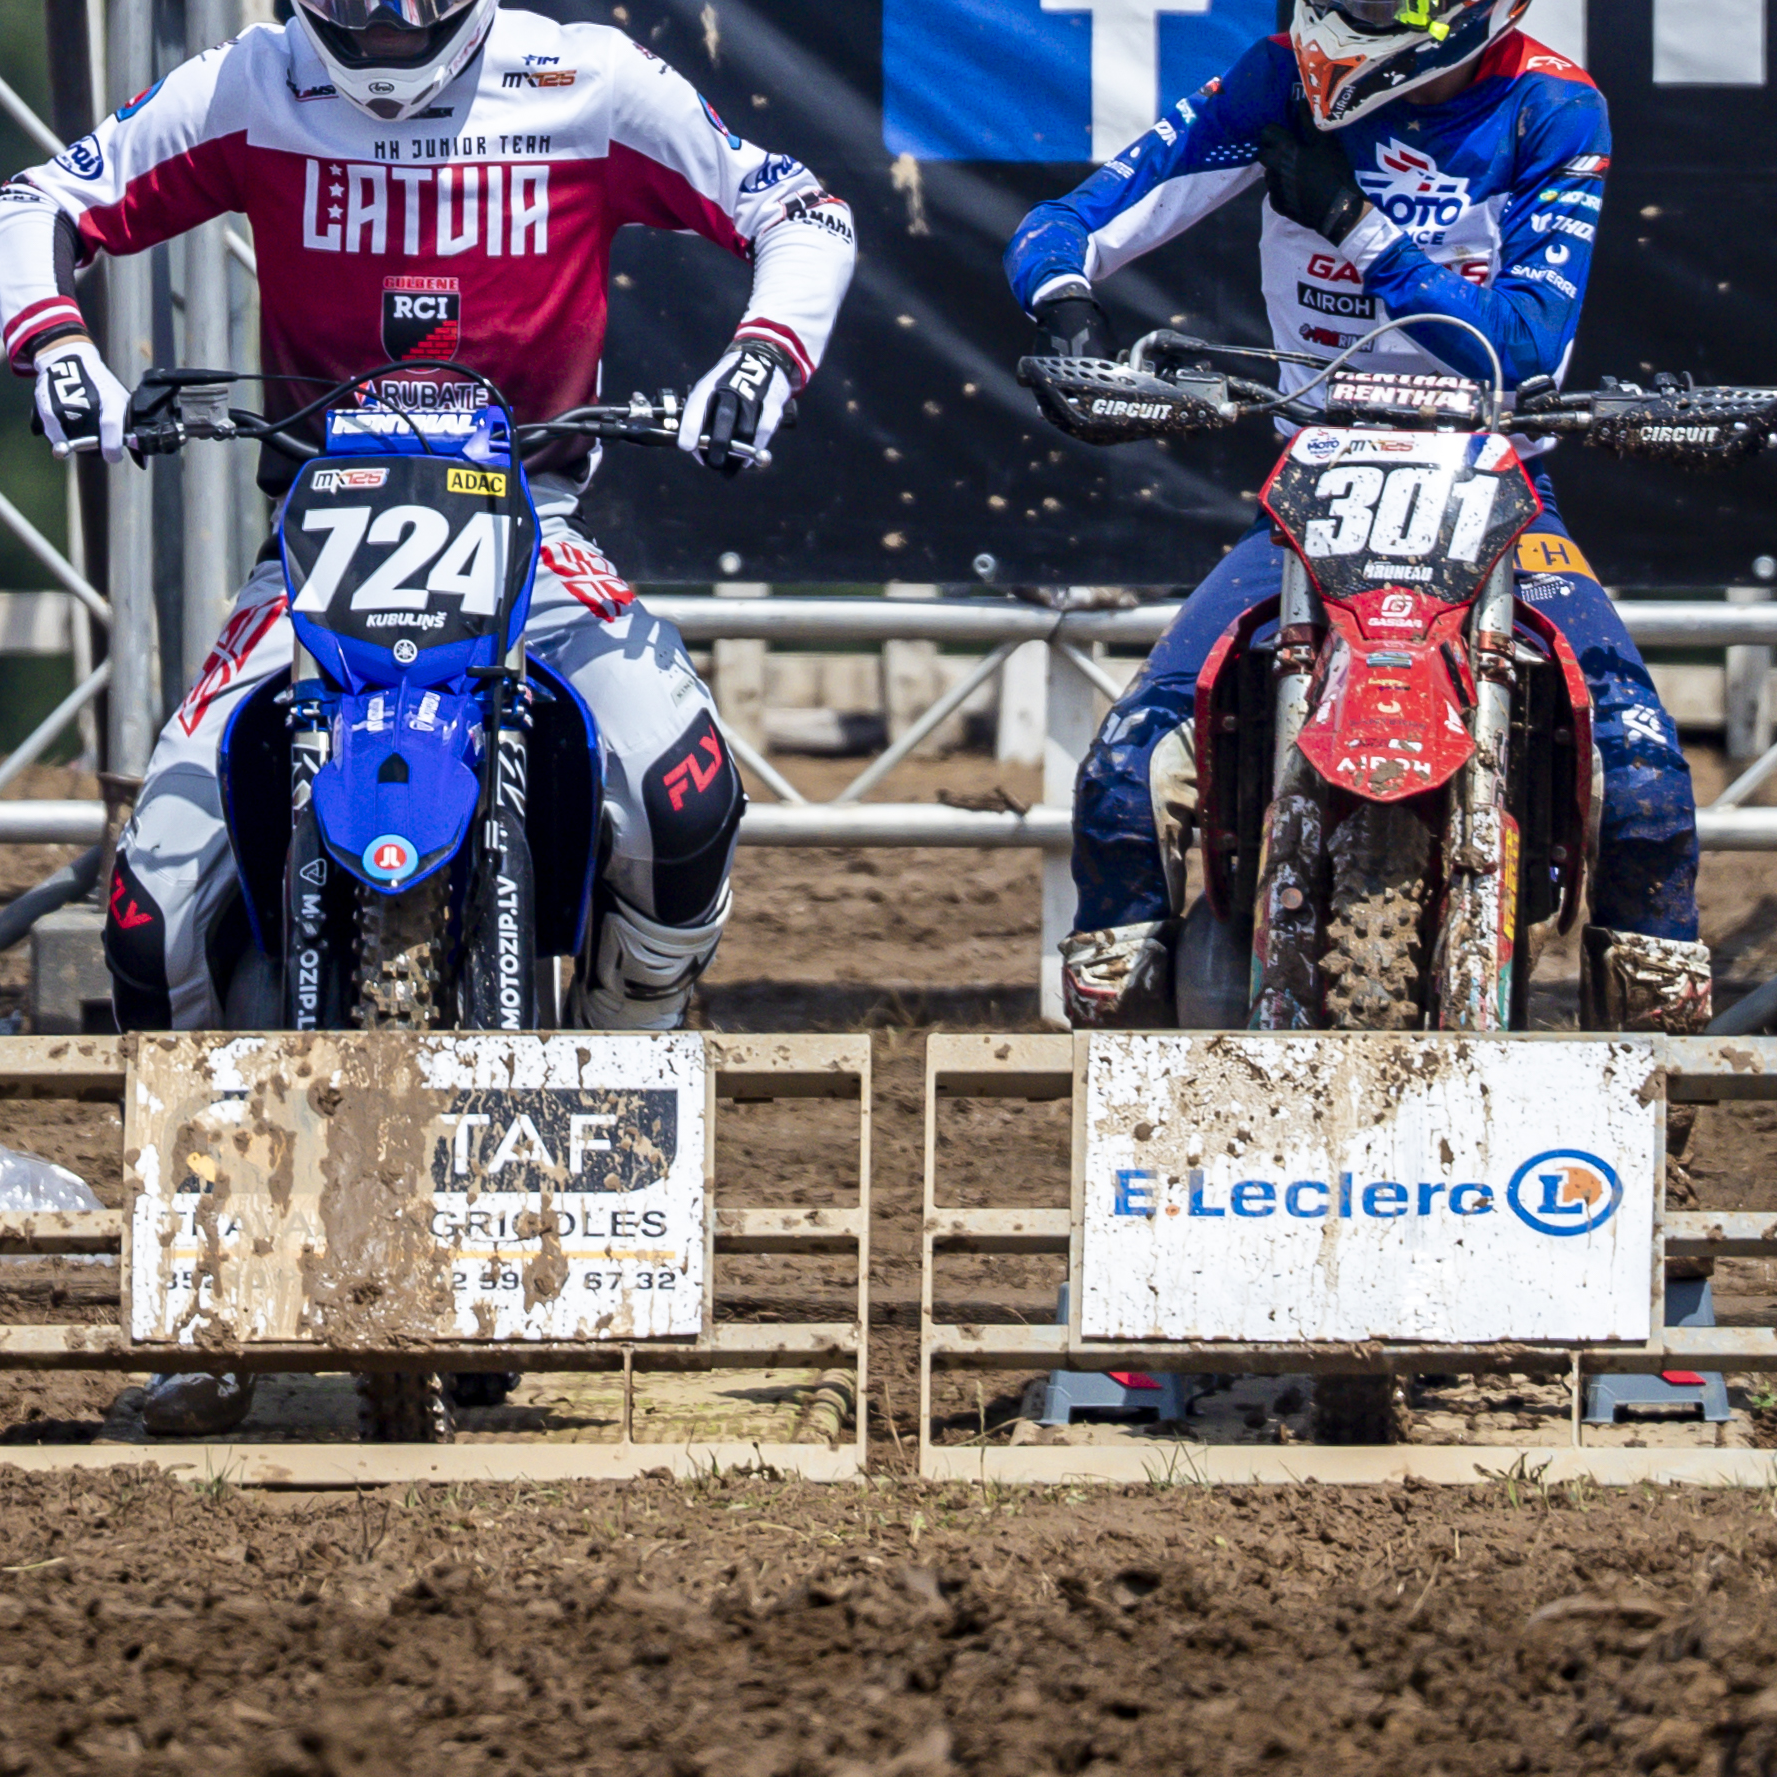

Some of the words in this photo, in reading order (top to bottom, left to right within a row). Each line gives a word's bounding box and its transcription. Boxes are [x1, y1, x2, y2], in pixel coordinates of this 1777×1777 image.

[411, 137, 488, 160] JUNIOR
[498, 134, 552, 156] TEAM
[393, 295, 448, 320] RCI
[1302, 290, 1371, 317] AIROH
[50, 360, 91, 410] FLY
[728, 351, 768, 402] FLY
[380, 380, 489, 411] RUBATE
[1333, 383, 1474, 411] RENTHAL
[1091, 398, 1173, 422] CIRCUIT
[1638, 425, 1718, 443] CIRCUIT
[450, 473, 504, 496] ADAC
[1302, 465, 1497, 564] 301
[292, 504, 520, 617] 724
[366, 609, 447, 631] KUBULIŅŠ
[663, 727, 723, 813] FLY
[440, 1113, 618, 1175] TAF
[1112, 1166, 1494, 1220] E.Leclerc
[636, 1270, 678, 1291] 32
